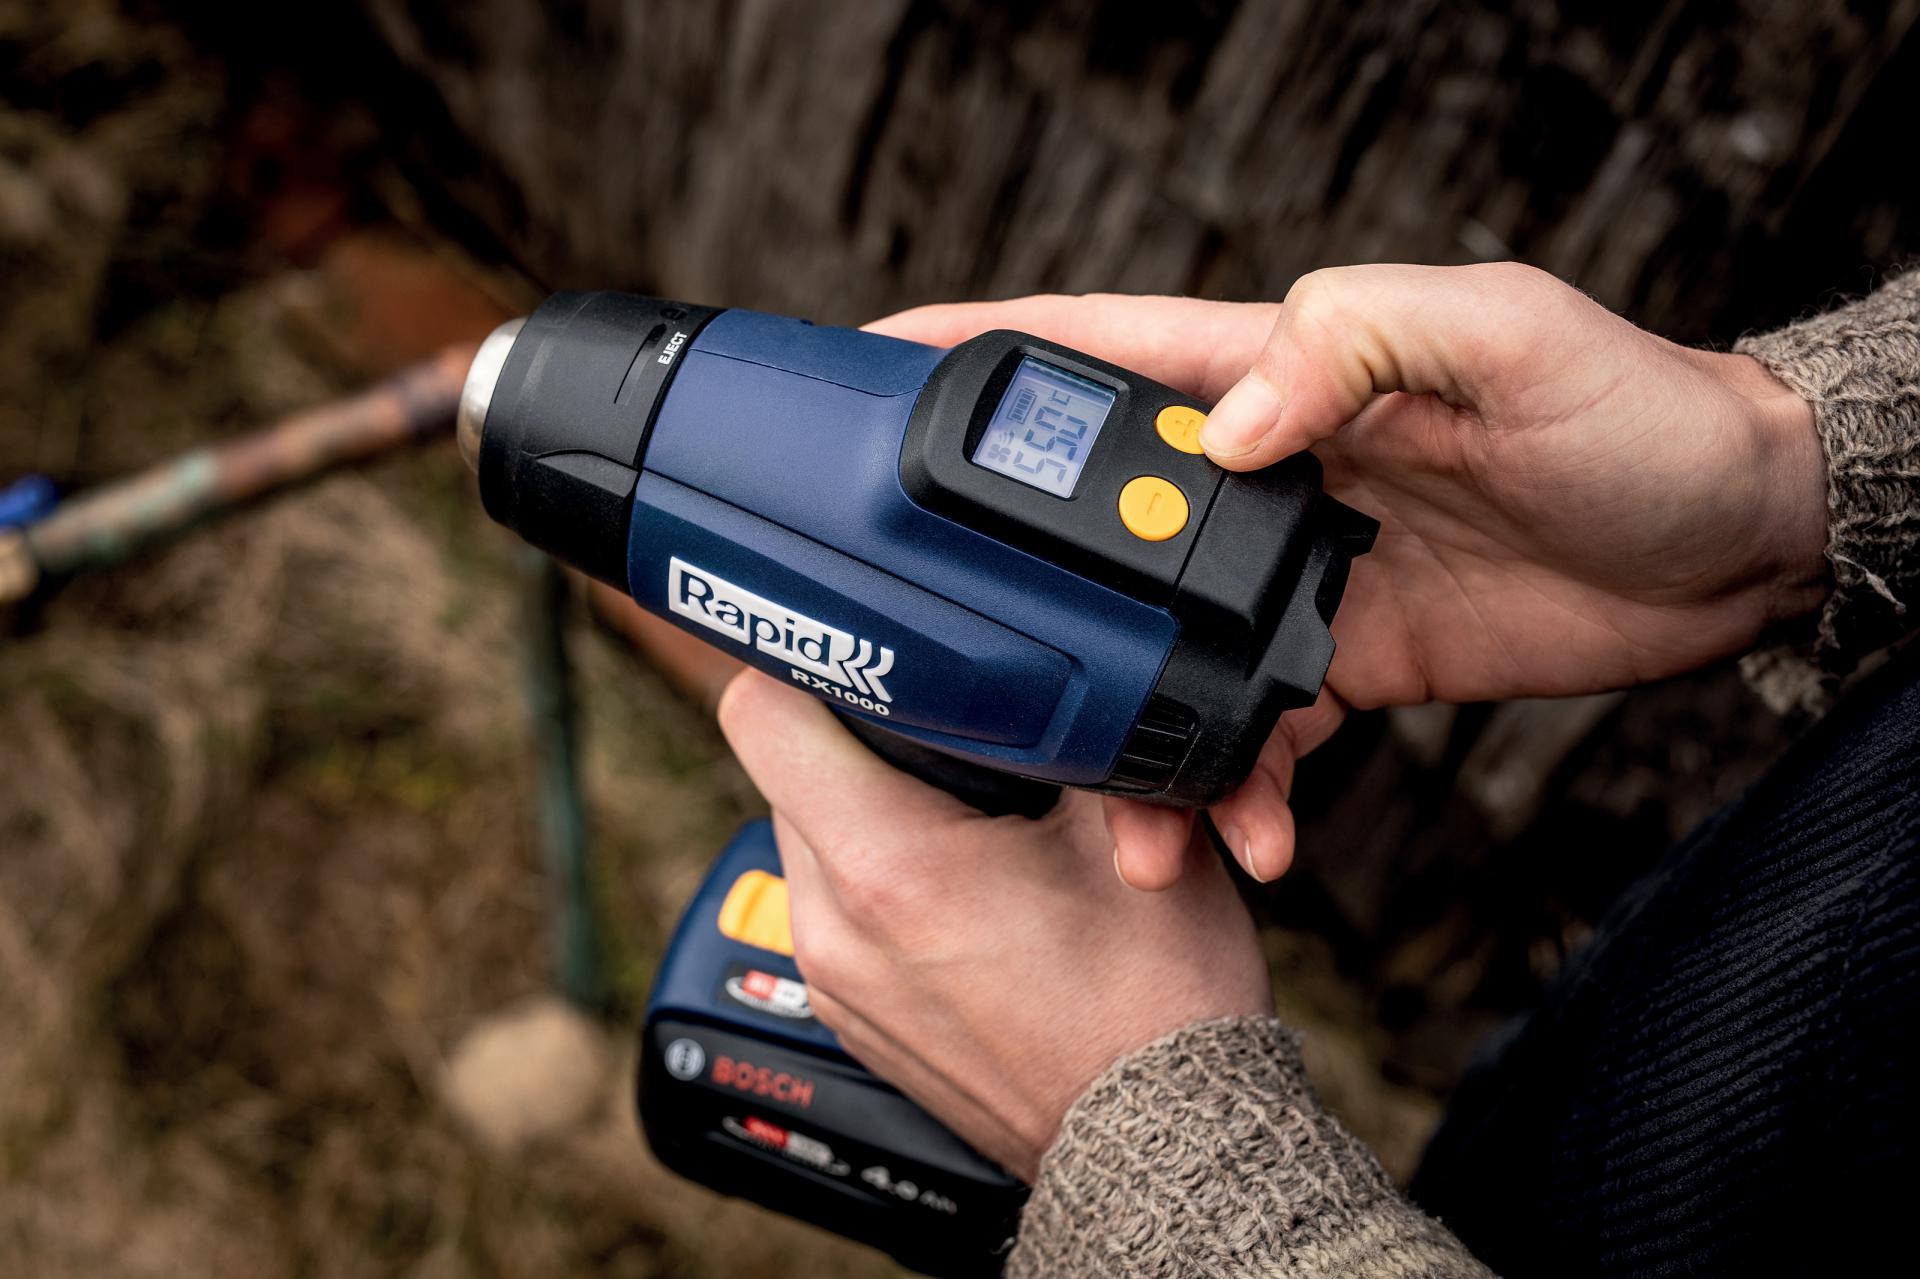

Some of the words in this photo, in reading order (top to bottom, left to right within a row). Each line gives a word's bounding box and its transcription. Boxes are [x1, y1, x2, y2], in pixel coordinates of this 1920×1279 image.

[657, 331, 687, 365] EJECT
[679, 568, 833, 668] Rapid
[791, 668, 890, 717] RX1000
[711, 1055, 815, 1109] BOSCH
